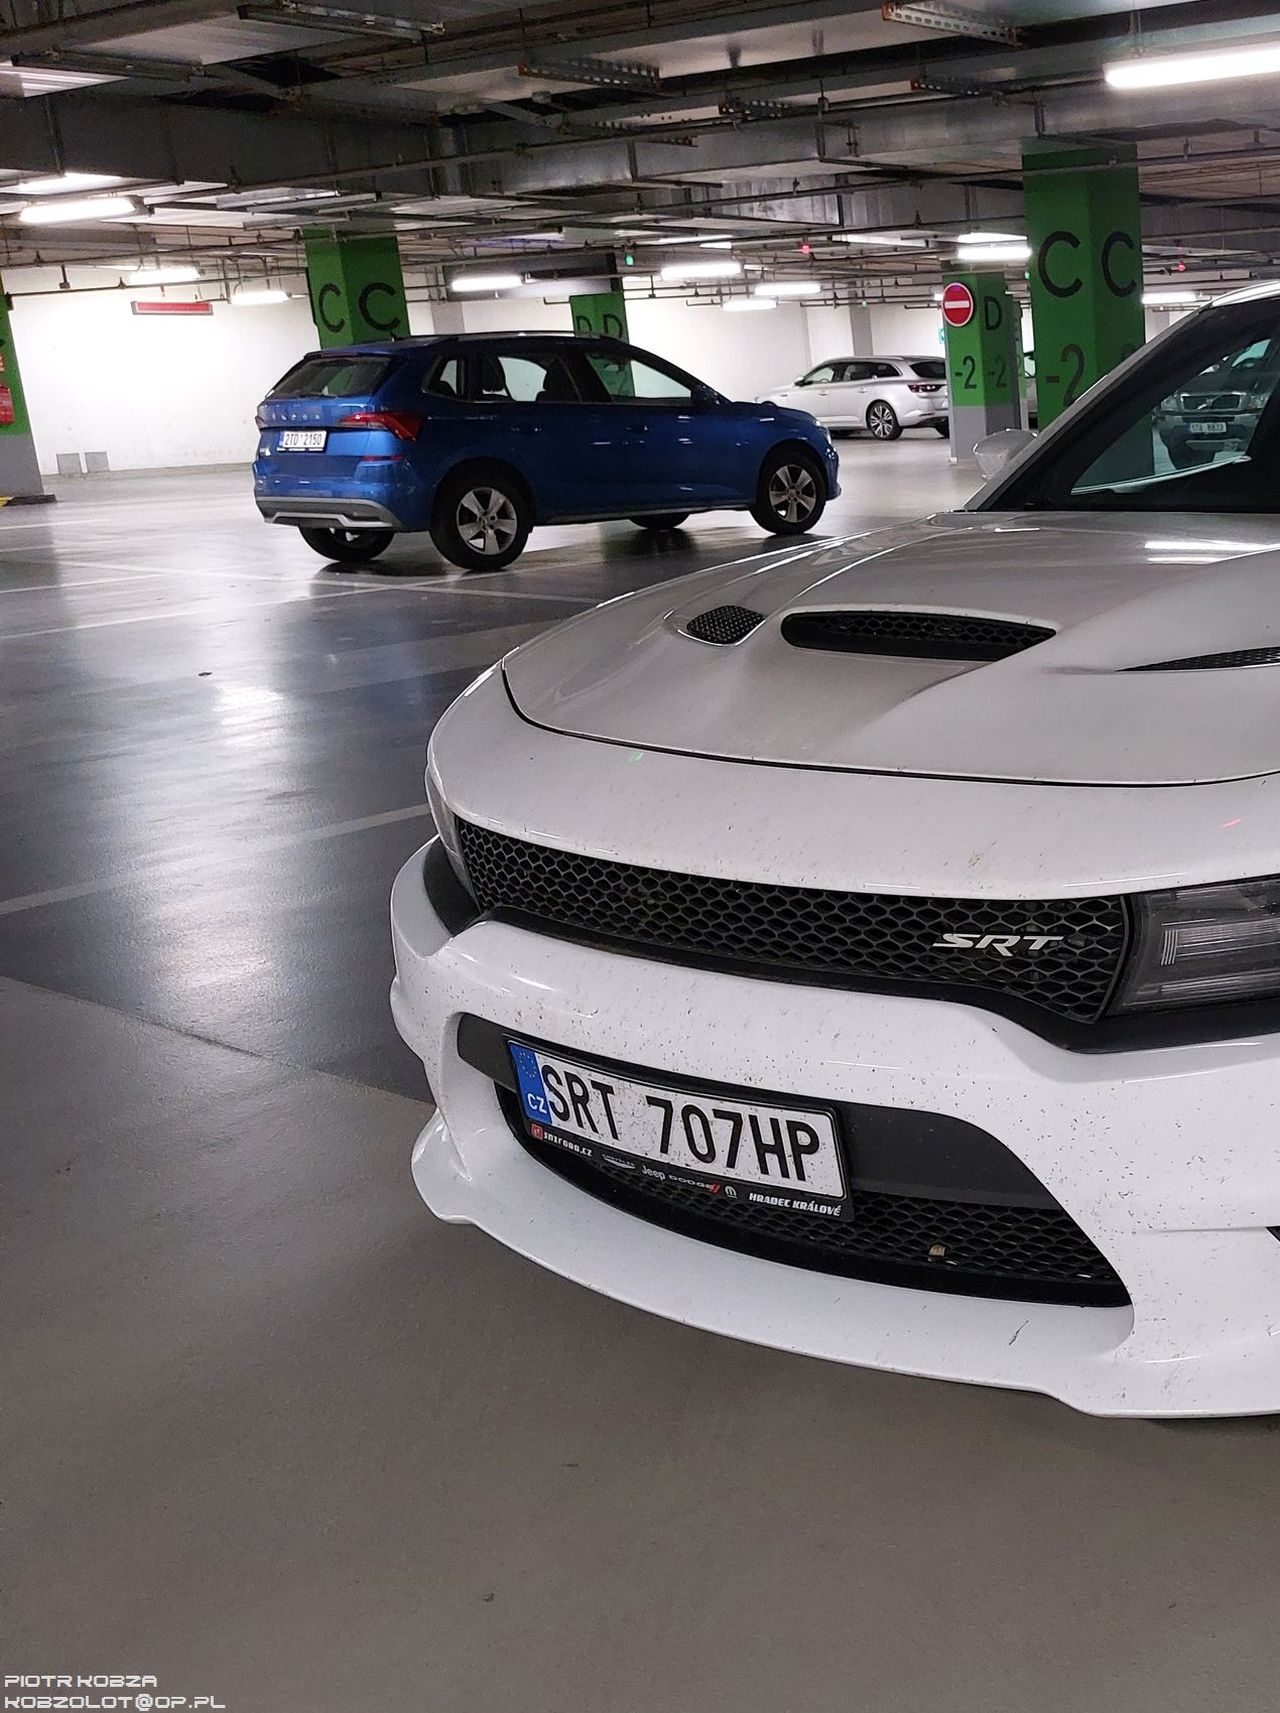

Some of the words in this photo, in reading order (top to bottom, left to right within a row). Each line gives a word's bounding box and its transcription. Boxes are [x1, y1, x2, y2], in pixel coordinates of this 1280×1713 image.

[1038, 231, 1083, 298] C
[1101, 231, 1137, 298] C
[319, 283, 345, 333] C
[359, 282, 400, 331] C
[984, 295, 1002, 331] D
[955, 355, 977, 389] -2
[303, 433, 322, 446] 2150
[932, 933, 1064, 957] SRT
[528, 1093, 547, 1113] CZ
[541, 1064, 620, 1141] SRT
[645, 1095, 820, 1182] 707HP
[641, 1165, 666, 1181] Jeep
[749, 1192, 791, 1209] HRADEC
[792, 1200, 841, 1217] KRÁLOVÉ
